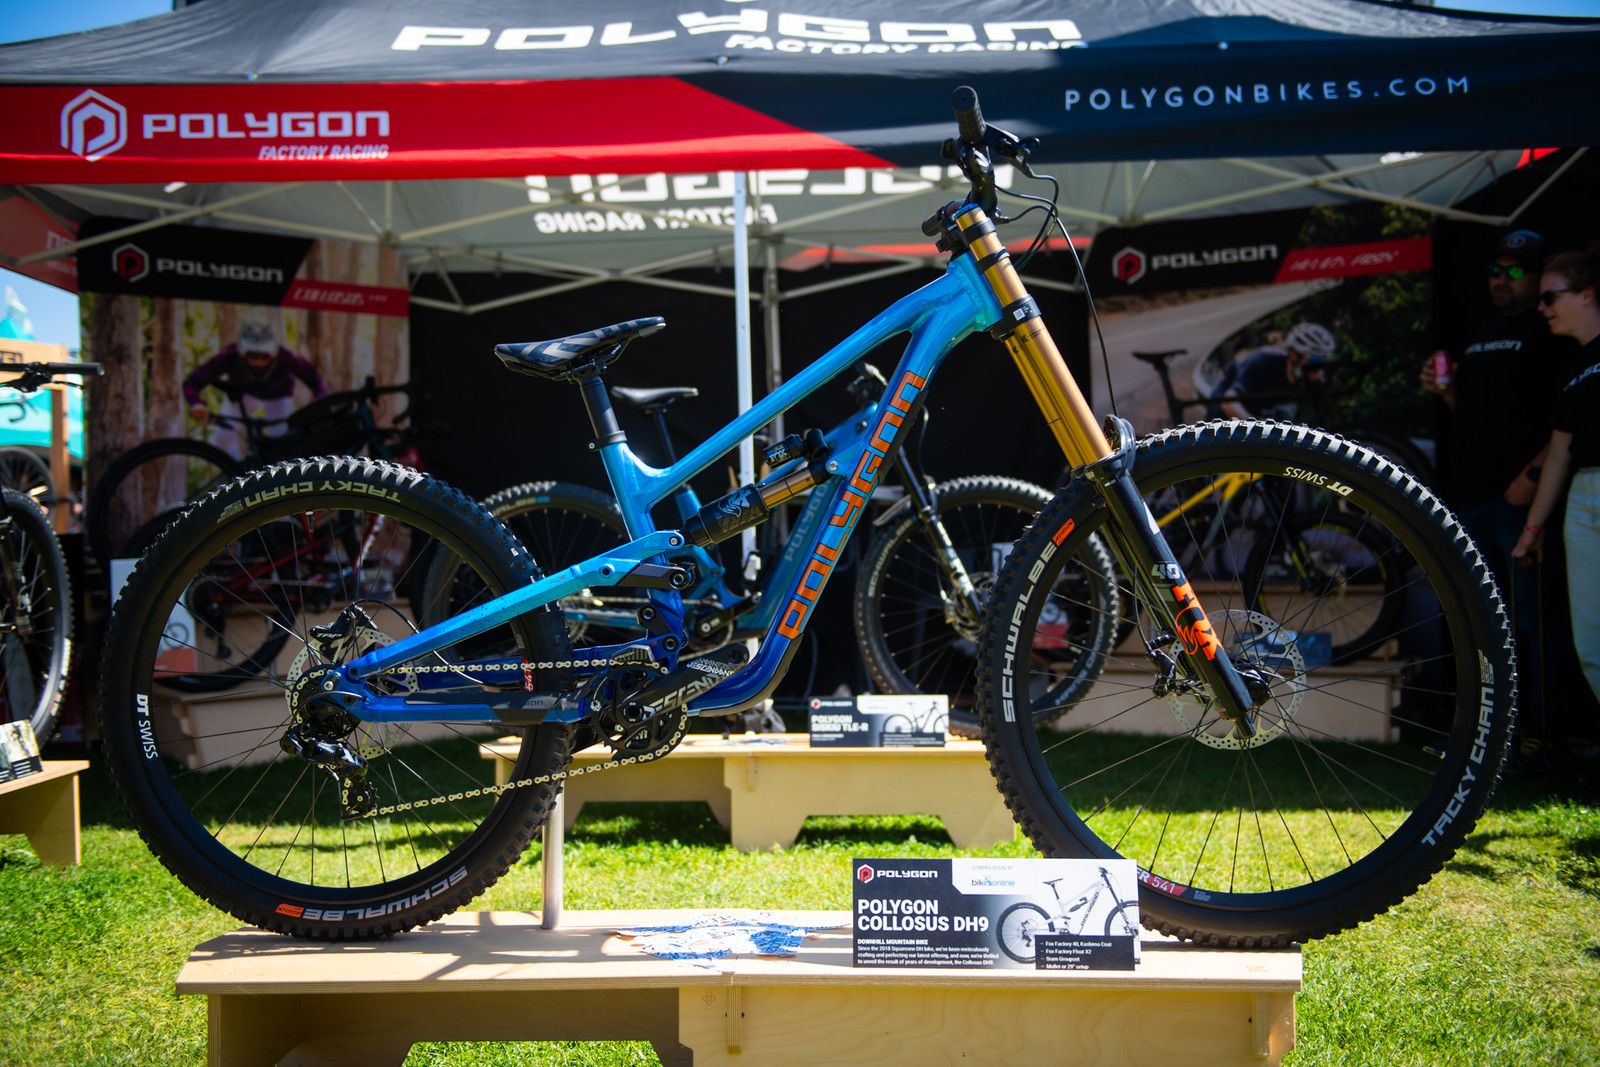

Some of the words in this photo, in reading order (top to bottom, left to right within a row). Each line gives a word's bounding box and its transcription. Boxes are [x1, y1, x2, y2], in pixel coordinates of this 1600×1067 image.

[391, 8, 1082, 50] POLYGON
[725, 34, 918, 54] FACTORY
[1065, 76, 1469, 110] POLYGONBIKES.COM
[143, 110, 389, 139] POLYGON
[258, 144, 328, 160] FACTORY
[329, 143, 389, 160] RACING
[1151, 243, 1278, 270] POLYGON
[156, 257, 283, 283] POLYGON
[1283, 466, 1328, 485] SWISS
[244, 481, 314, 507] CHAN
[319, 480, 401, 503] TACKY
[1326, 481, 1354, 496] DT
[776, 370, 928, 640] POLYGON
[1151, 563, 1181, 580] 40
[1002, 541, 1057, 723] SCHWALBE
[136, 694, 149, 716] DT
[138, 720, 159, 760] SWISS
[1421, 765, 1476, 847] TACKY
[1470, 686, 1495, 765] CHAN
[877, 870, 938, 878] POLYGON
[971, 878, 1015, 887] bikesonline
[1152, 876, 1175, 894] 541
[302, 865, 468, 921] SCHWALBE
[857, 899, 939, 915] POLYGON
[857, 916, 950, 931] COLLOSUS
[953, 916, 990, 932] DH9
